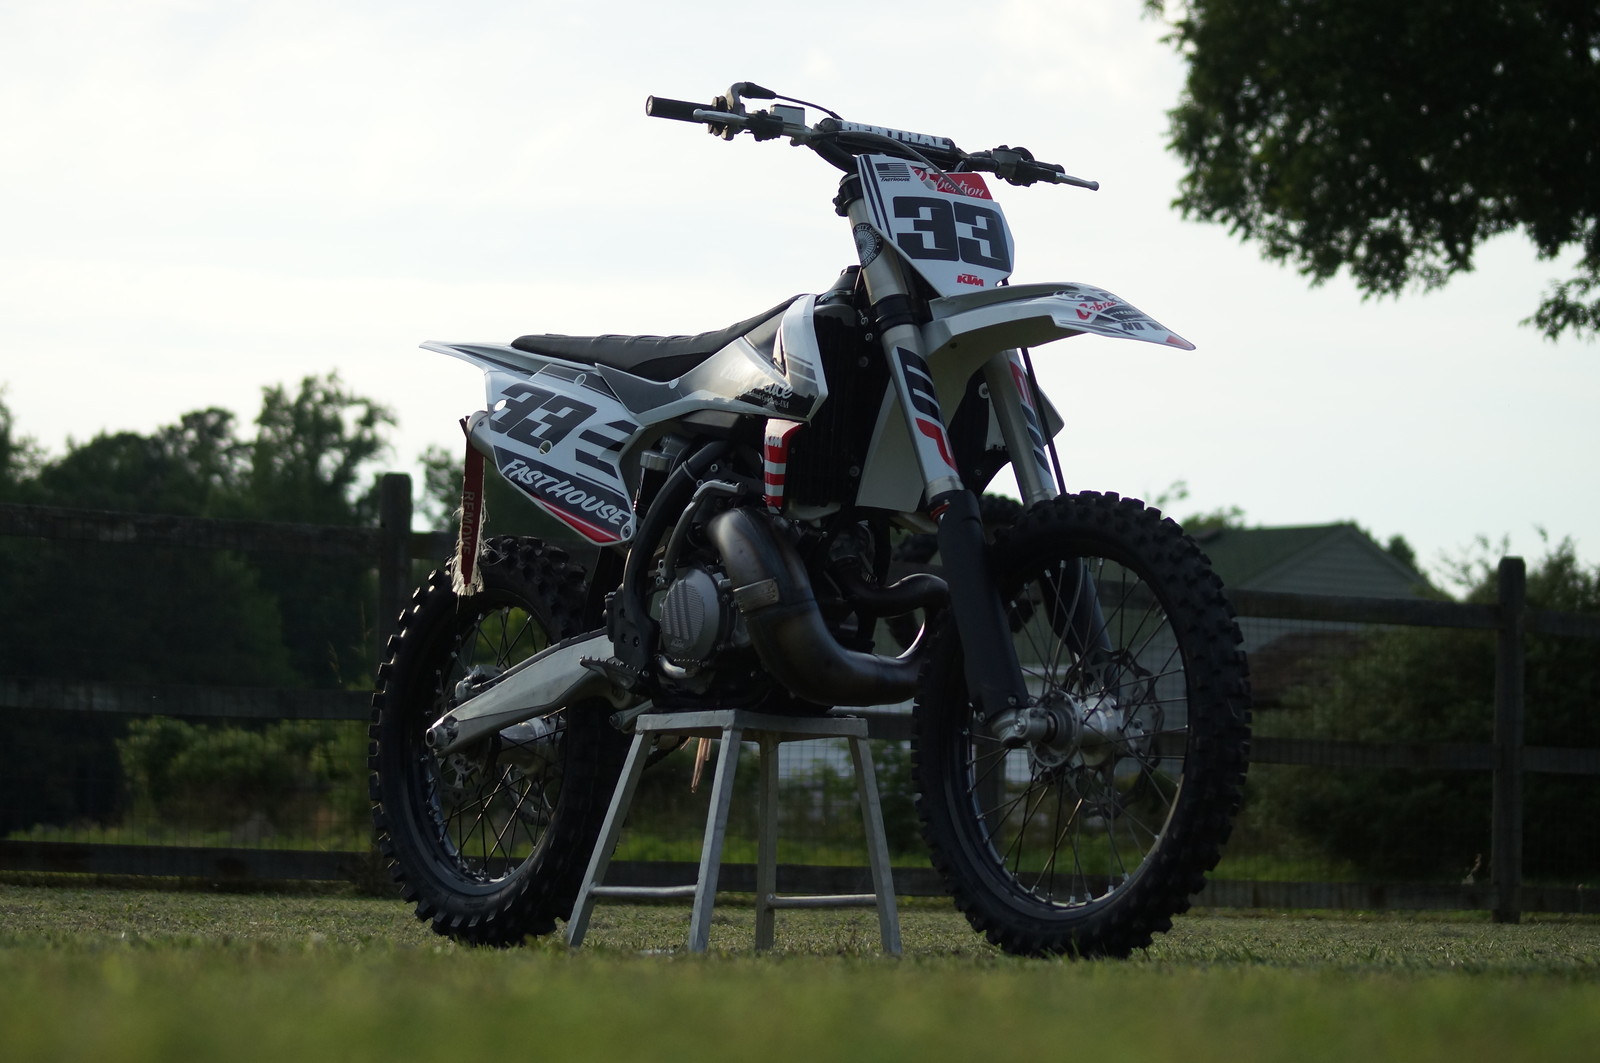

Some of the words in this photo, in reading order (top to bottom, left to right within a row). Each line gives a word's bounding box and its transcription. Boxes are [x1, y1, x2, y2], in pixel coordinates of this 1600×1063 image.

[841, 121, 950, 150] RENTHAL
[893, 196, 1012, 273] 33
[957, 273, 984, 287] KTM
[489, 383, 598, 449] 33
[462, 490, 476, 556] REMOVE
[501, 459, 631, 526] FASTHOUSE
